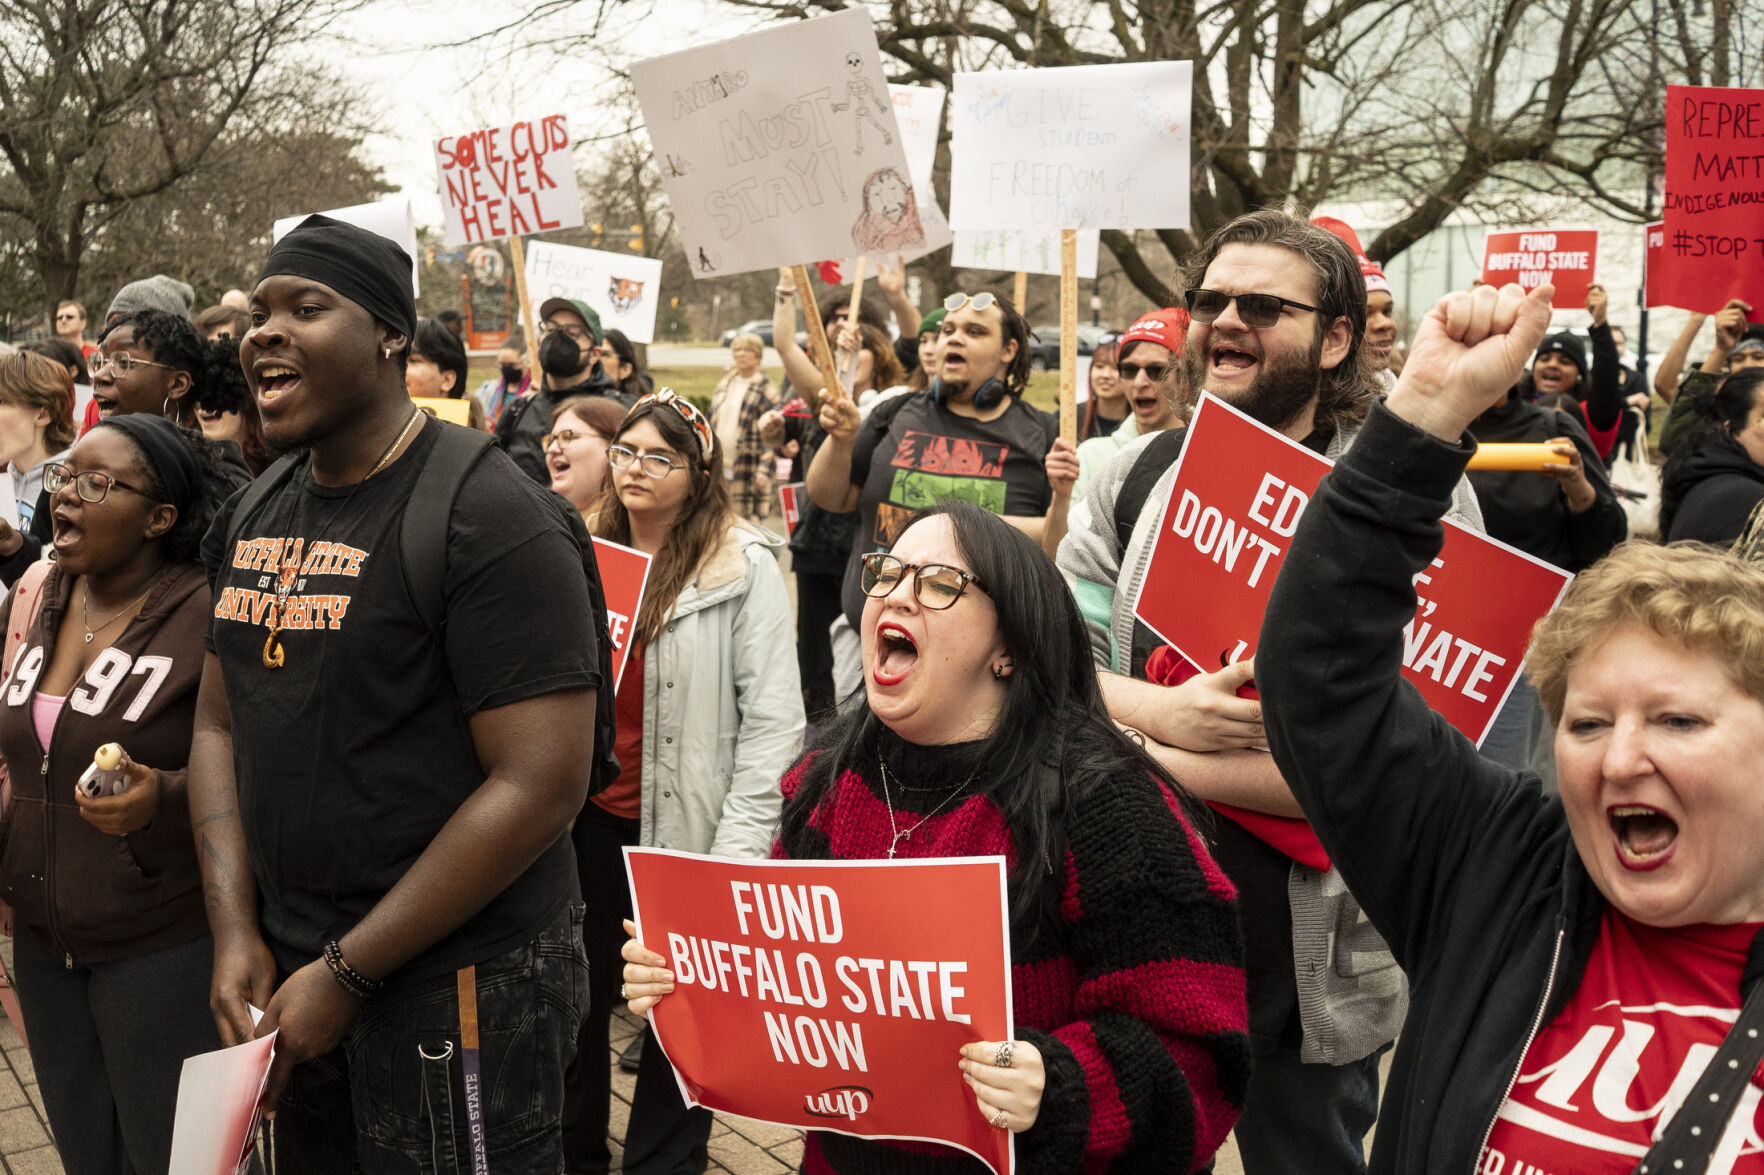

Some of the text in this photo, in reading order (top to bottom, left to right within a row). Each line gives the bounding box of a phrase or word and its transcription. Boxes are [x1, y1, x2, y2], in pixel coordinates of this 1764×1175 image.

[718, 86, 832, 167] MUST
[1006, 87, 1096, 129] GIVE
[1683, 97, 1764, 139] REPRE
[437, 128, 503, 170] SOME
[1038, 128, 1117, 149] STUDENTS
[445, 155, 558, 208] NEVER
[704, 147, 849, 241] STAY!
[988, 159, 1141, 204] FREEDOM of
[460, 192, 561, 243] HEAL
[1487, 251, 1589, 271] BUFFALO STATE
[1518, 233, 1557, 252] FUND
[1673, 229, 1747, 260] #STOP
[532, 248, 595, 281] Hear
[1518, 270, 1554, 288] NOW
[232, 537, 366, 577] UFFALO STATE
[1172, 488, 1281, 588] DON'T
[258, 575, 271, 589] EST
[730, 880, 843, 944] FUND
[667, 932, 972, 1025] BUFFALO STATE
[764, 1011, 869, 1072] NOW
[465, 1073, 480, 1121] STATE
